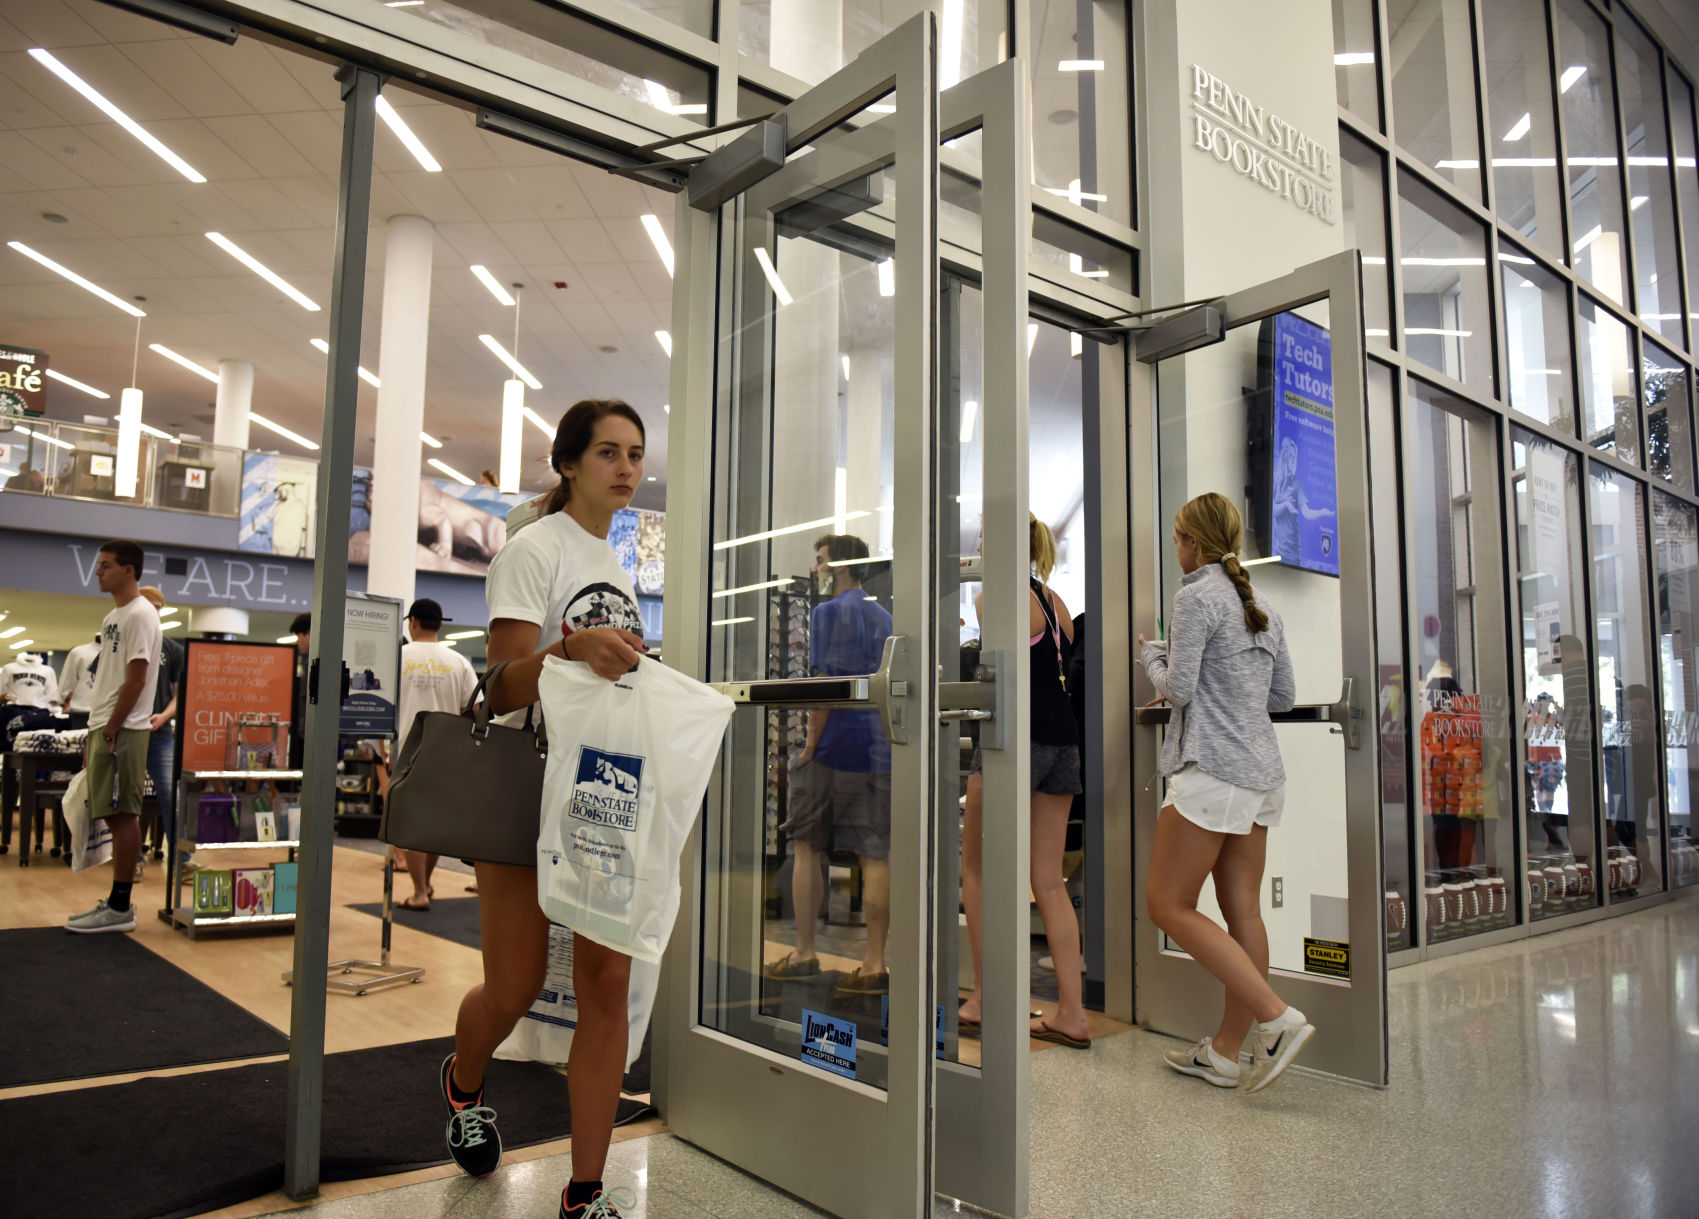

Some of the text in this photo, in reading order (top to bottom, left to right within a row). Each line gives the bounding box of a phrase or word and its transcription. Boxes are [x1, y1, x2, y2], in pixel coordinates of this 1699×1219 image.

[1191, 63, 1333, 181] PENN STATE
[1193, 112, 1336, 226] BOOKSTORE
[1282, 332, 1323, 372] Tech
[1433, 689, 1463, 711] PENN
[194, 728, 226, 745] GIF
[1434, 717, 1497, 738] BOOKSTORE
[572, 803, 634, 828] BOOKSTORE
[1309, 948, 1344, 961] STANLEY
[806, 1047, 835, 1063] ACCEPTED
[835, 1057, 851, 1069] HERE
